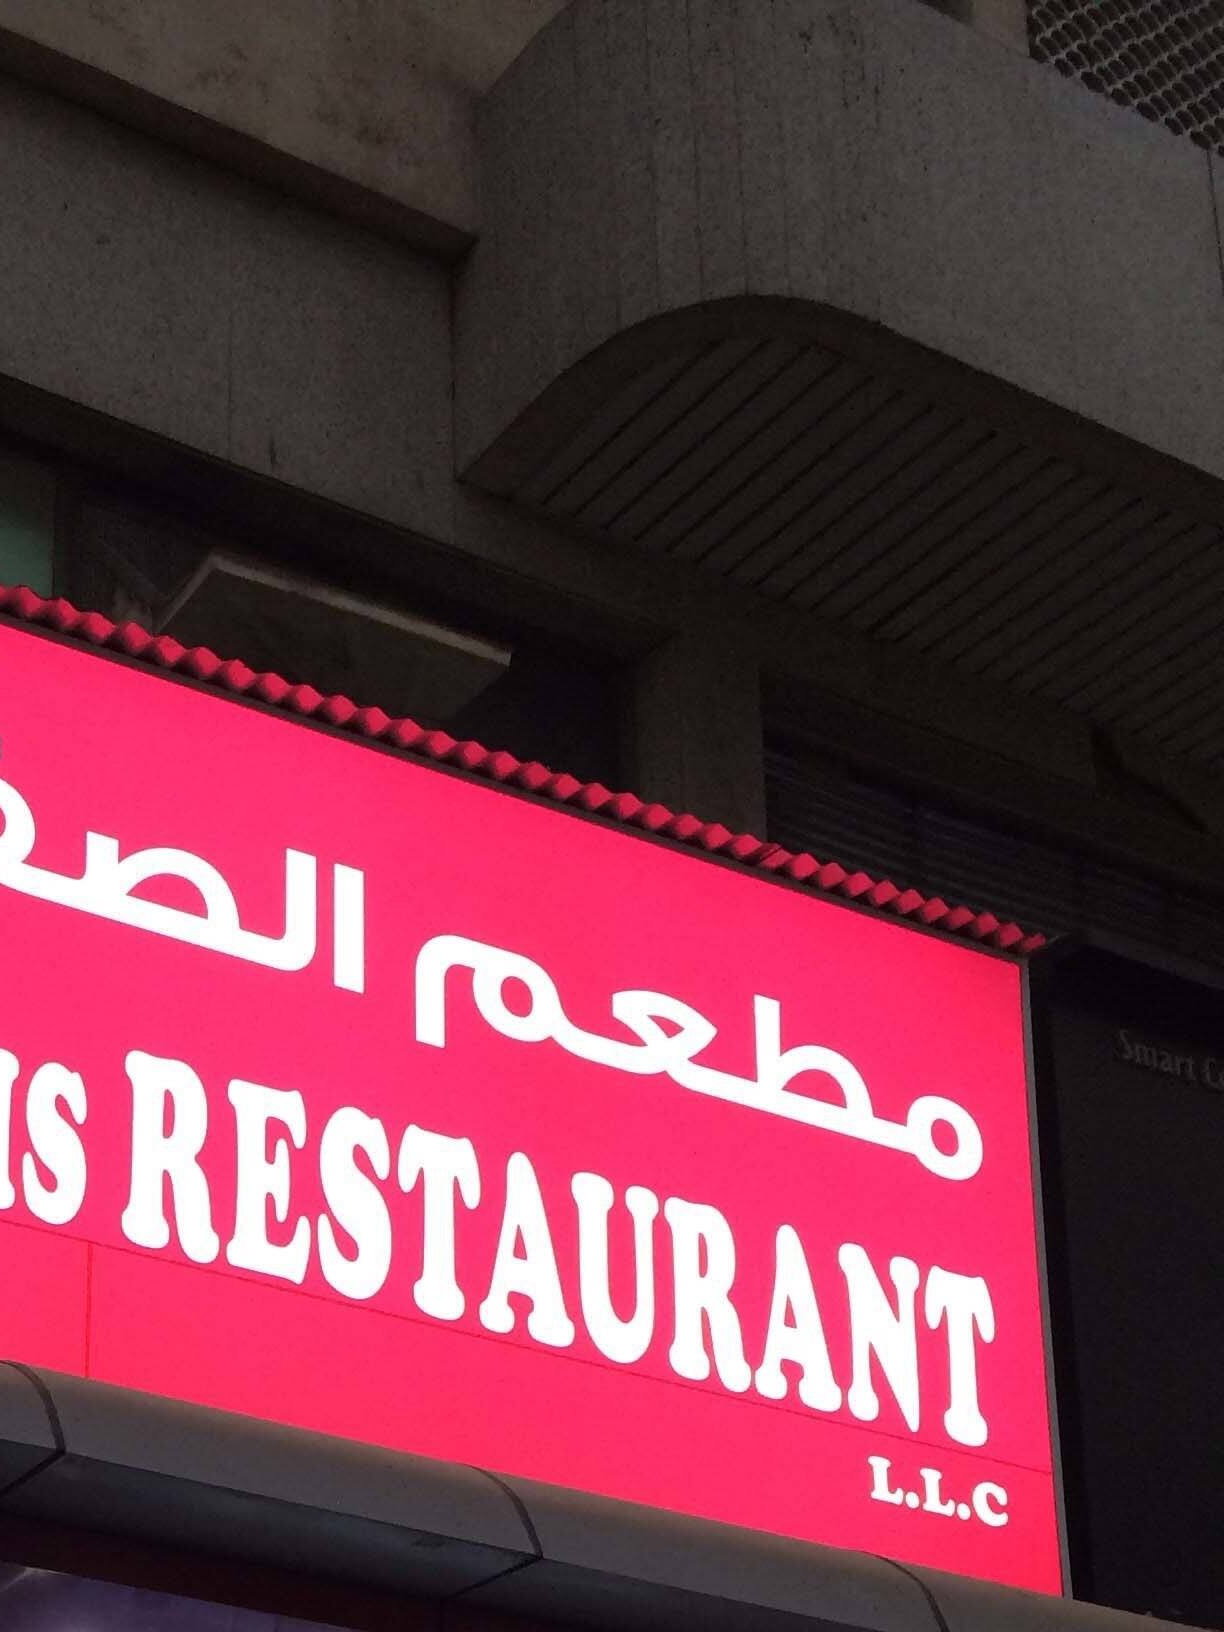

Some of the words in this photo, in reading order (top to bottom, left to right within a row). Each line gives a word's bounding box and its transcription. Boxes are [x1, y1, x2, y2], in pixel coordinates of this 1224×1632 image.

[415, 935, 983, 1181] مطعم
[1119, 1029, 1197, 1081] Smart
[121, 1050, 995, 1447] RESTAURANT
[868, 1455, 1009, 1527] L.L.C
